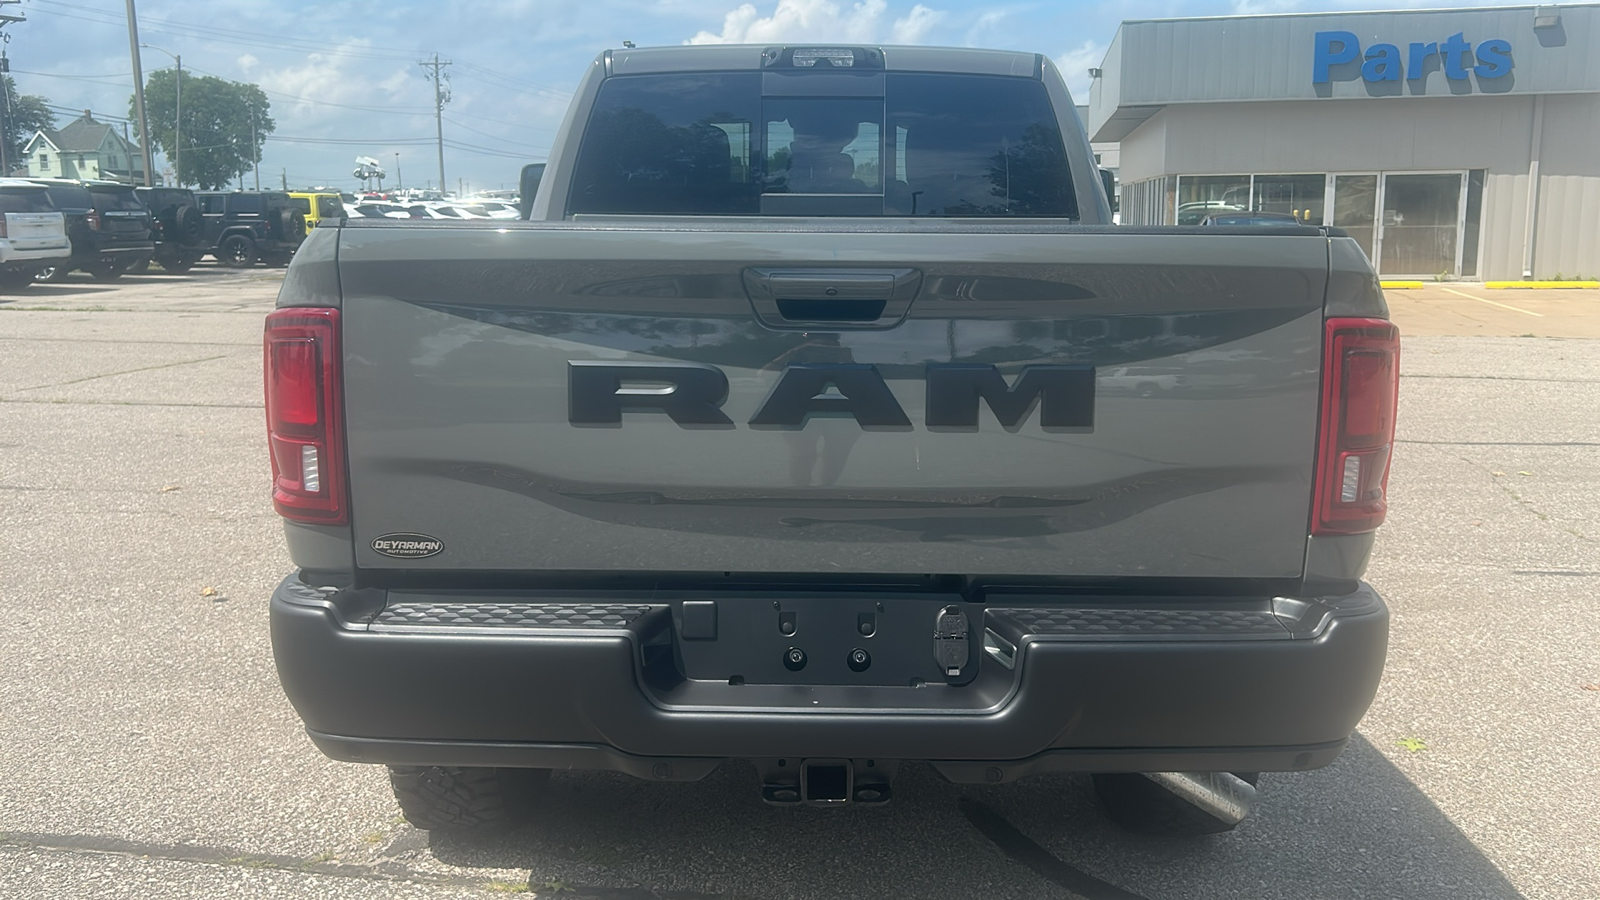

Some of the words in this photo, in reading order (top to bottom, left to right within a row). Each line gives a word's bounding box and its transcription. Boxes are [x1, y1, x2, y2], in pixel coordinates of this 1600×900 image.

[1313, 30, 1512, 84] Parts
[567, 359, 1096, 432] RAM
[374, 540, 440, 550] DEYARMAN
